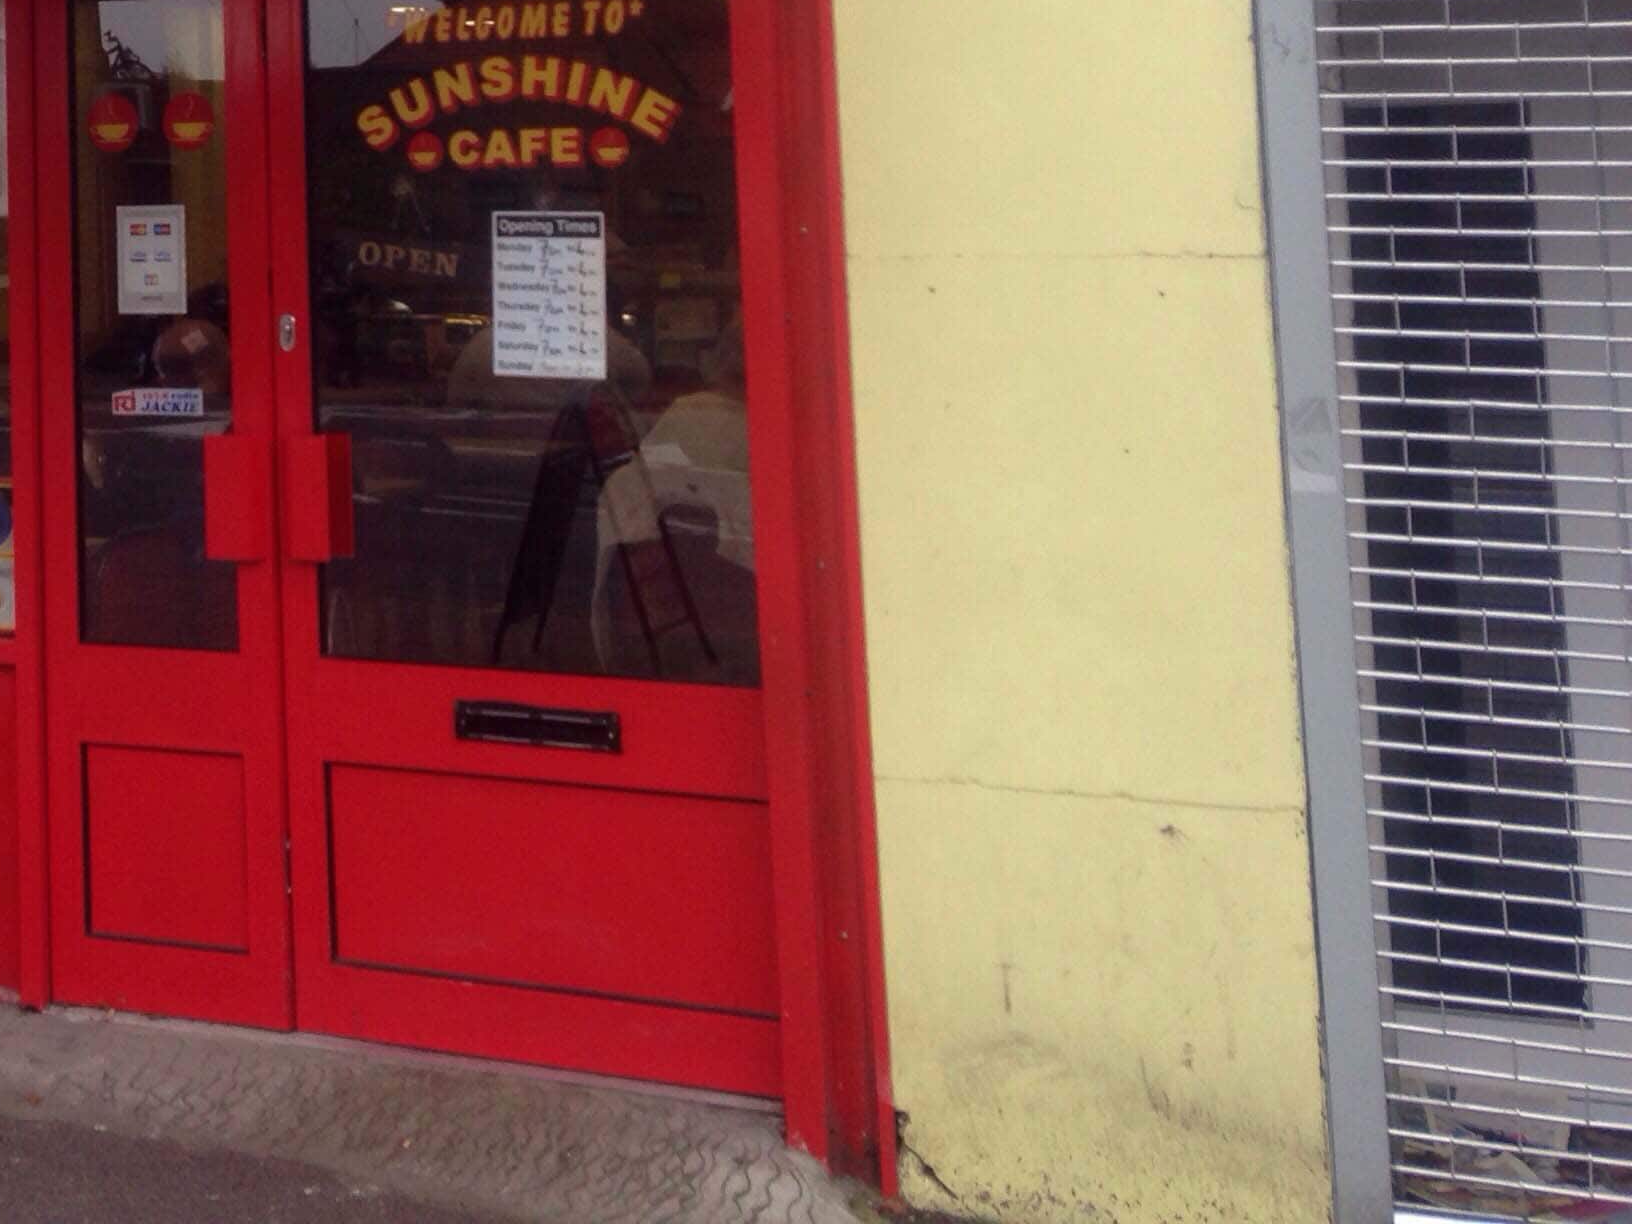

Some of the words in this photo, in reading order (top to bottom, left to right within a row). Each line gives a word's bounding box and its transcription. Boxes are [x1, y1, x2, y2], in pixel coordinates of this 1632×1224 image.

[401, 2, 572, 45] WELCOME
[357, 55, 682, 151] SUNSHINE
[448, 126, 585, 169] CAFE
[498, 218, 553, 236] Opening
[555, 218, 598, 234] Times
[358, 240, 459, 277] OPEN
